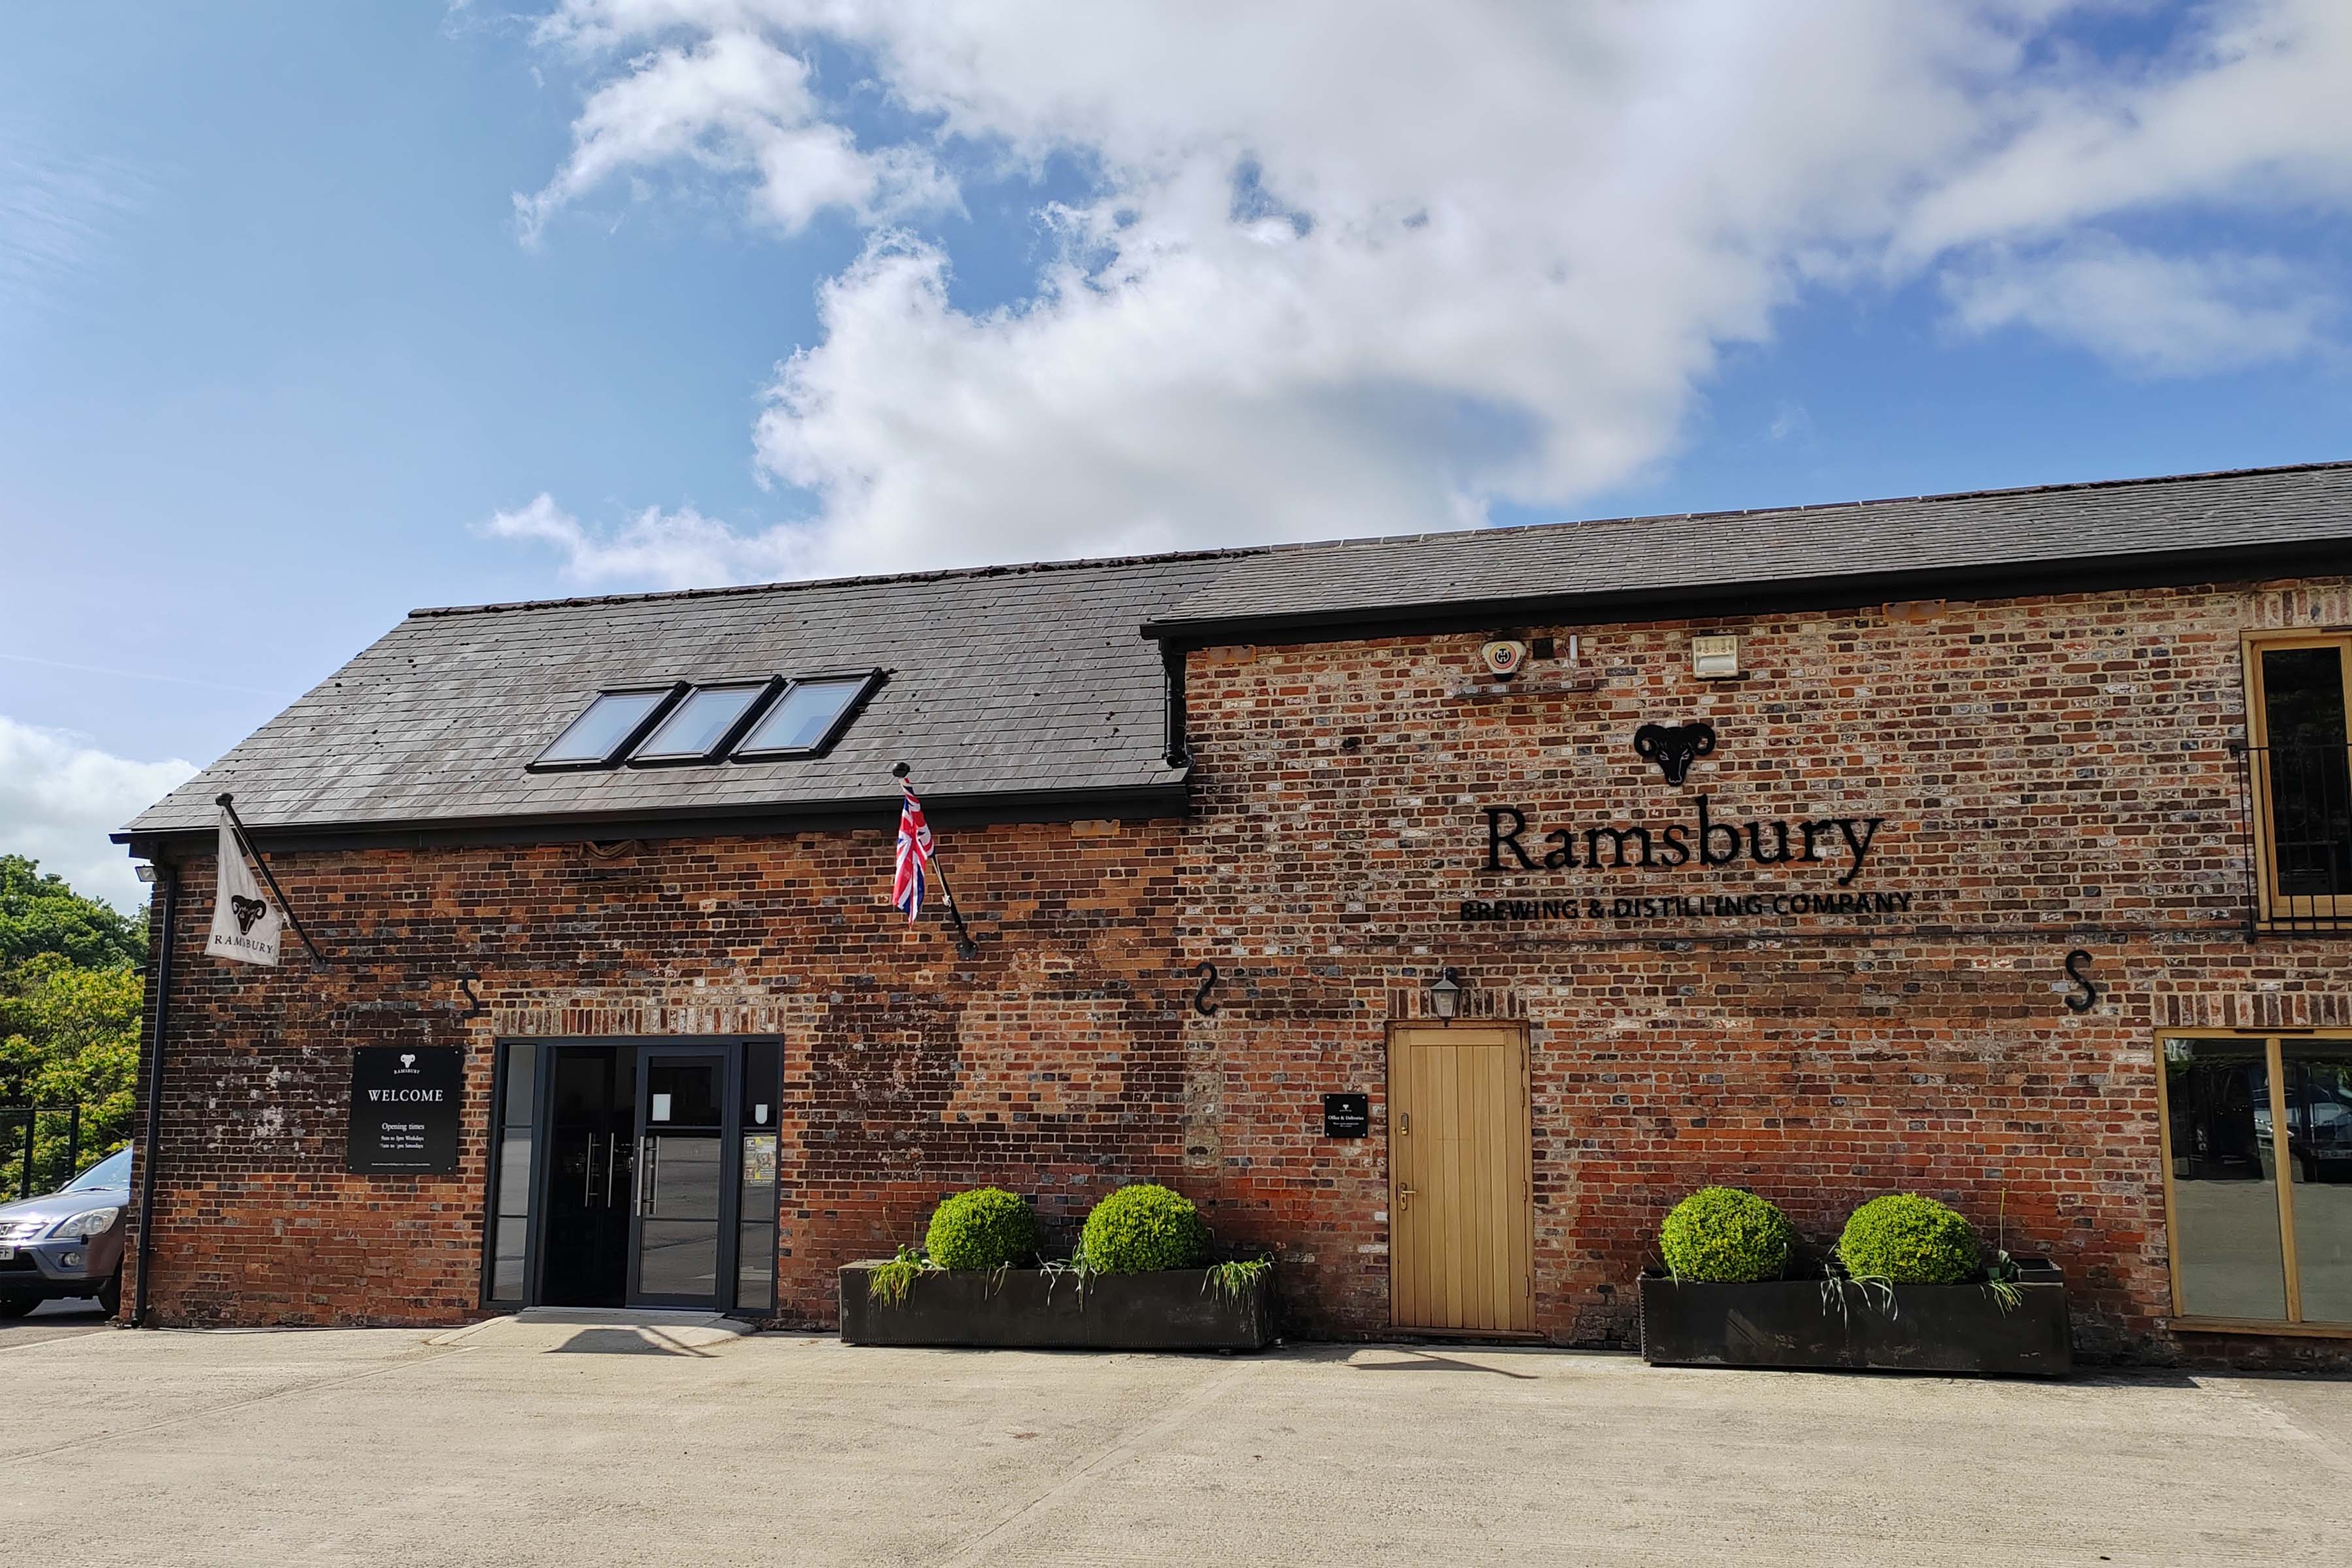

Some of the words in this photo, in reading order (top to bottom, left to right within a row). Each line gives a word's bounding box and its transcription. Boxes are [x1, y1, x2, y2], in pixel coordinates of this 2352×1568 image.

[1480, 793, 1886, 886] Ramsbury
[1460, 899, 1578, 921] BREWING
[1588, 898, 1605, 919] &
[1612, 895, 1763, 918] DISTILLING
[1772, 892, 1912, 915] COMPANY
[214, 935, 273, 954] RAMSBURY
[368, 1089, 444, 1102] WELCOME
[382, 1122, 407, 1132] Opening
